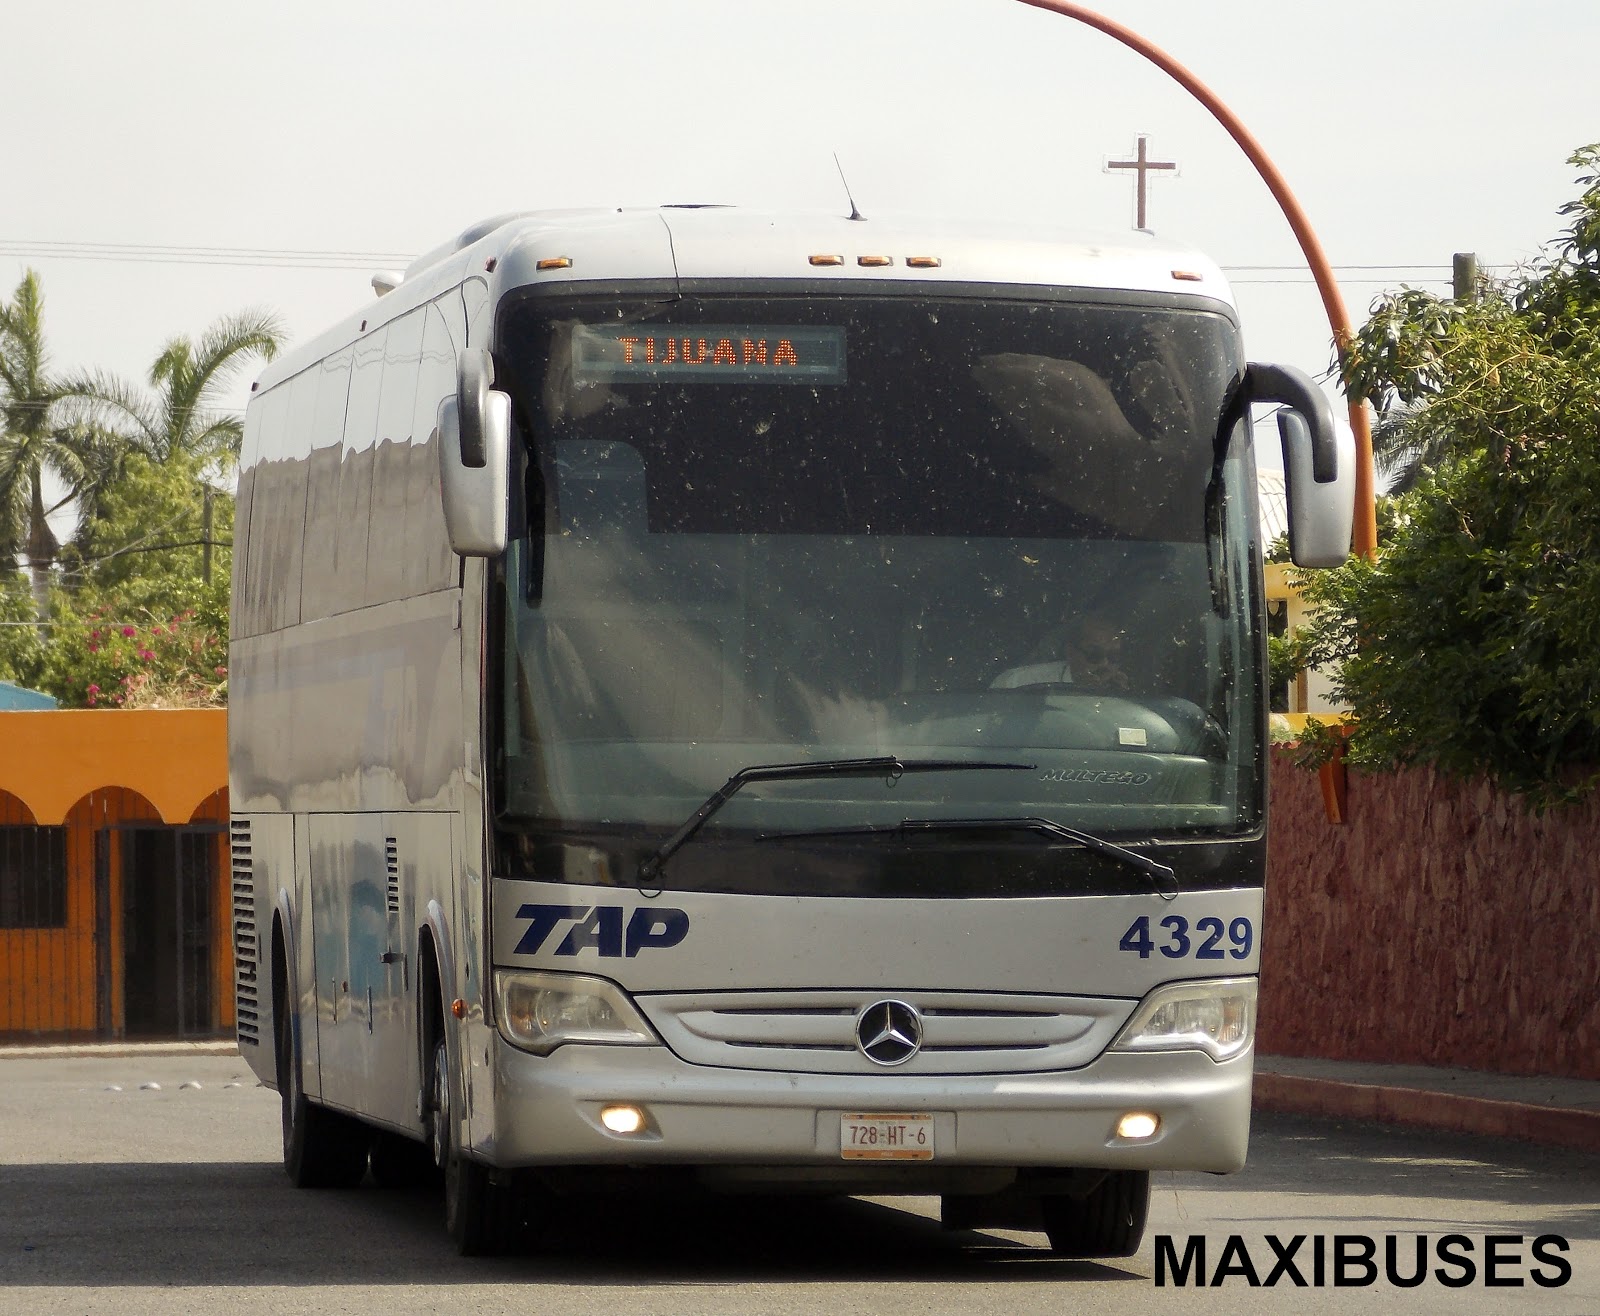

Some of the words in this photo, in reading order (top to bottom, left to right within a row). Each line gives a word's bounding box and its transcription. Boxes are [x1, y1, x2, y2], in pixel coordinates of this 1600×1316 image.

[619, 337, 798, 366] TIJUANA
[513, 904, 690, 958] TAP
[1119, 915, 1253, 960] 4329
[850, 1125, 926, 1145] 728-HT-6
